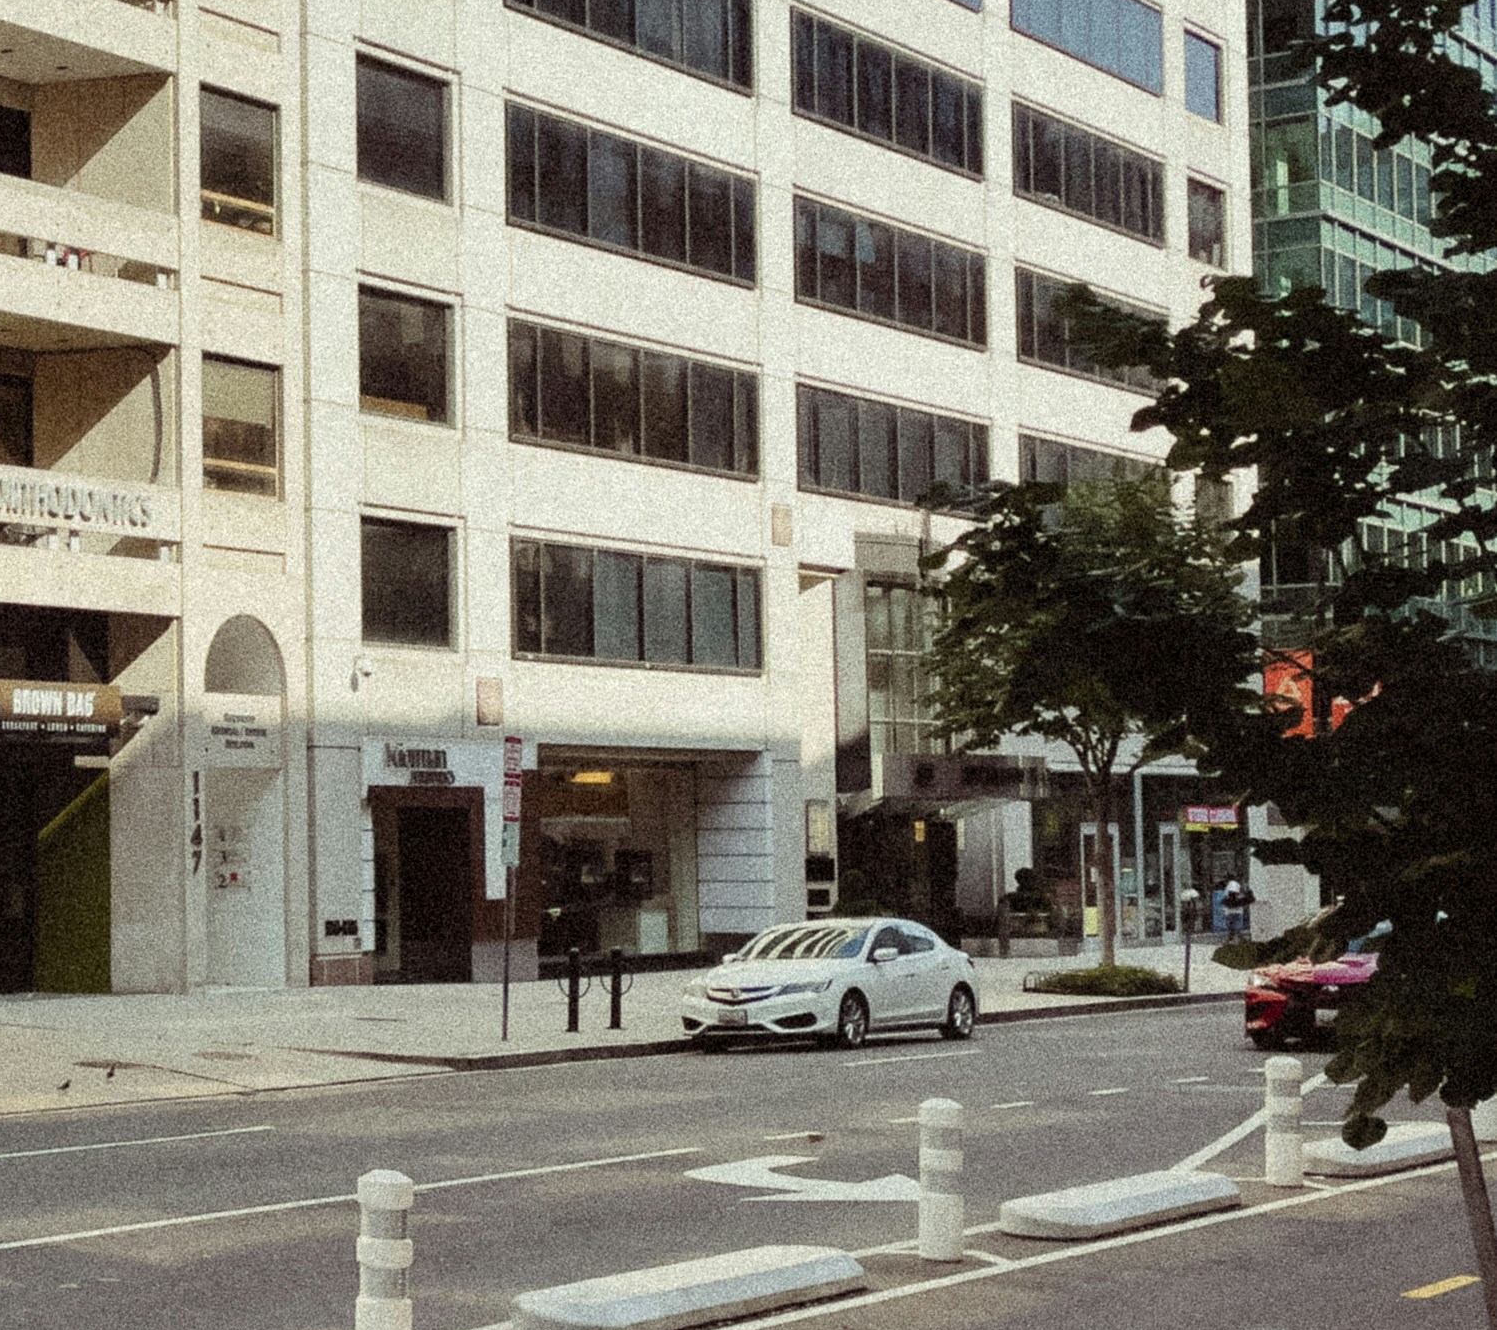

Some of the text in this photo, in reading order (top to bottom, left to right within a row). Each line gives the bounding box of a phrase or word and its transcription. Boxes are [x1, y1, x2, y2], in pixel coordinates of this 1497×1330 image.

[12, 688, 63, 716] BROWN
[66, 690, 96, 717] BAG
[190, 770, 203, 877] 1147
